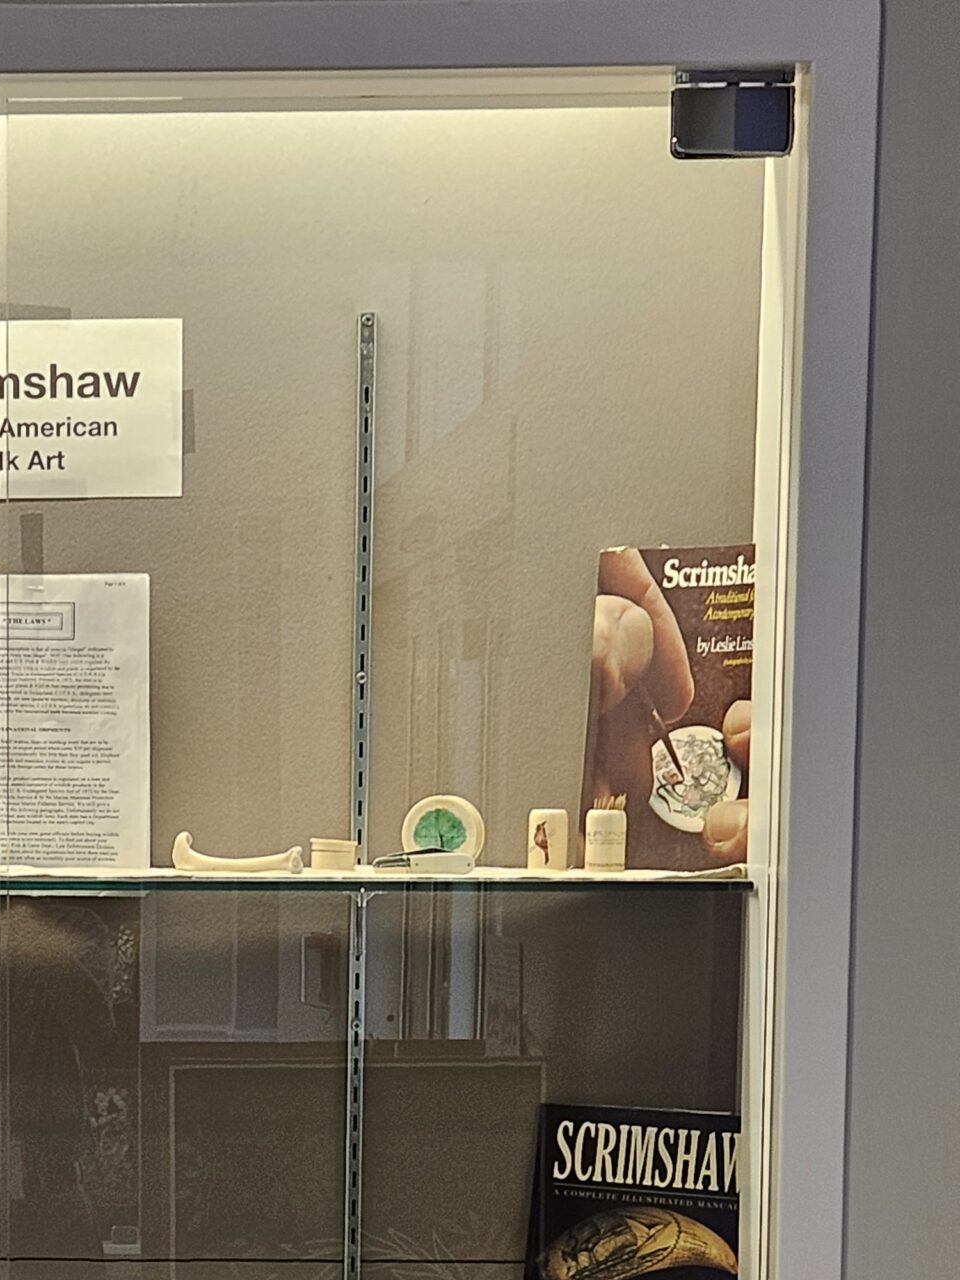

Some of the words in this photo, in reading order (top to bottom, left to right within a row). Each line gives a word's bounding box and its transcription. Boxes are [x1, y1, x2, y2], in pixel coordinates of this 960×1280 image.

[27, 450, 65, 471] Art
[662, 555, 756, 589] Scrimsha
[696, 635, 711, 657] by
[710, 635, 736, 653] Leslie
[564, 1190, 618, 1201] COMPLETE
[622, 1194, 693, 1208] ILLUSTRATED
